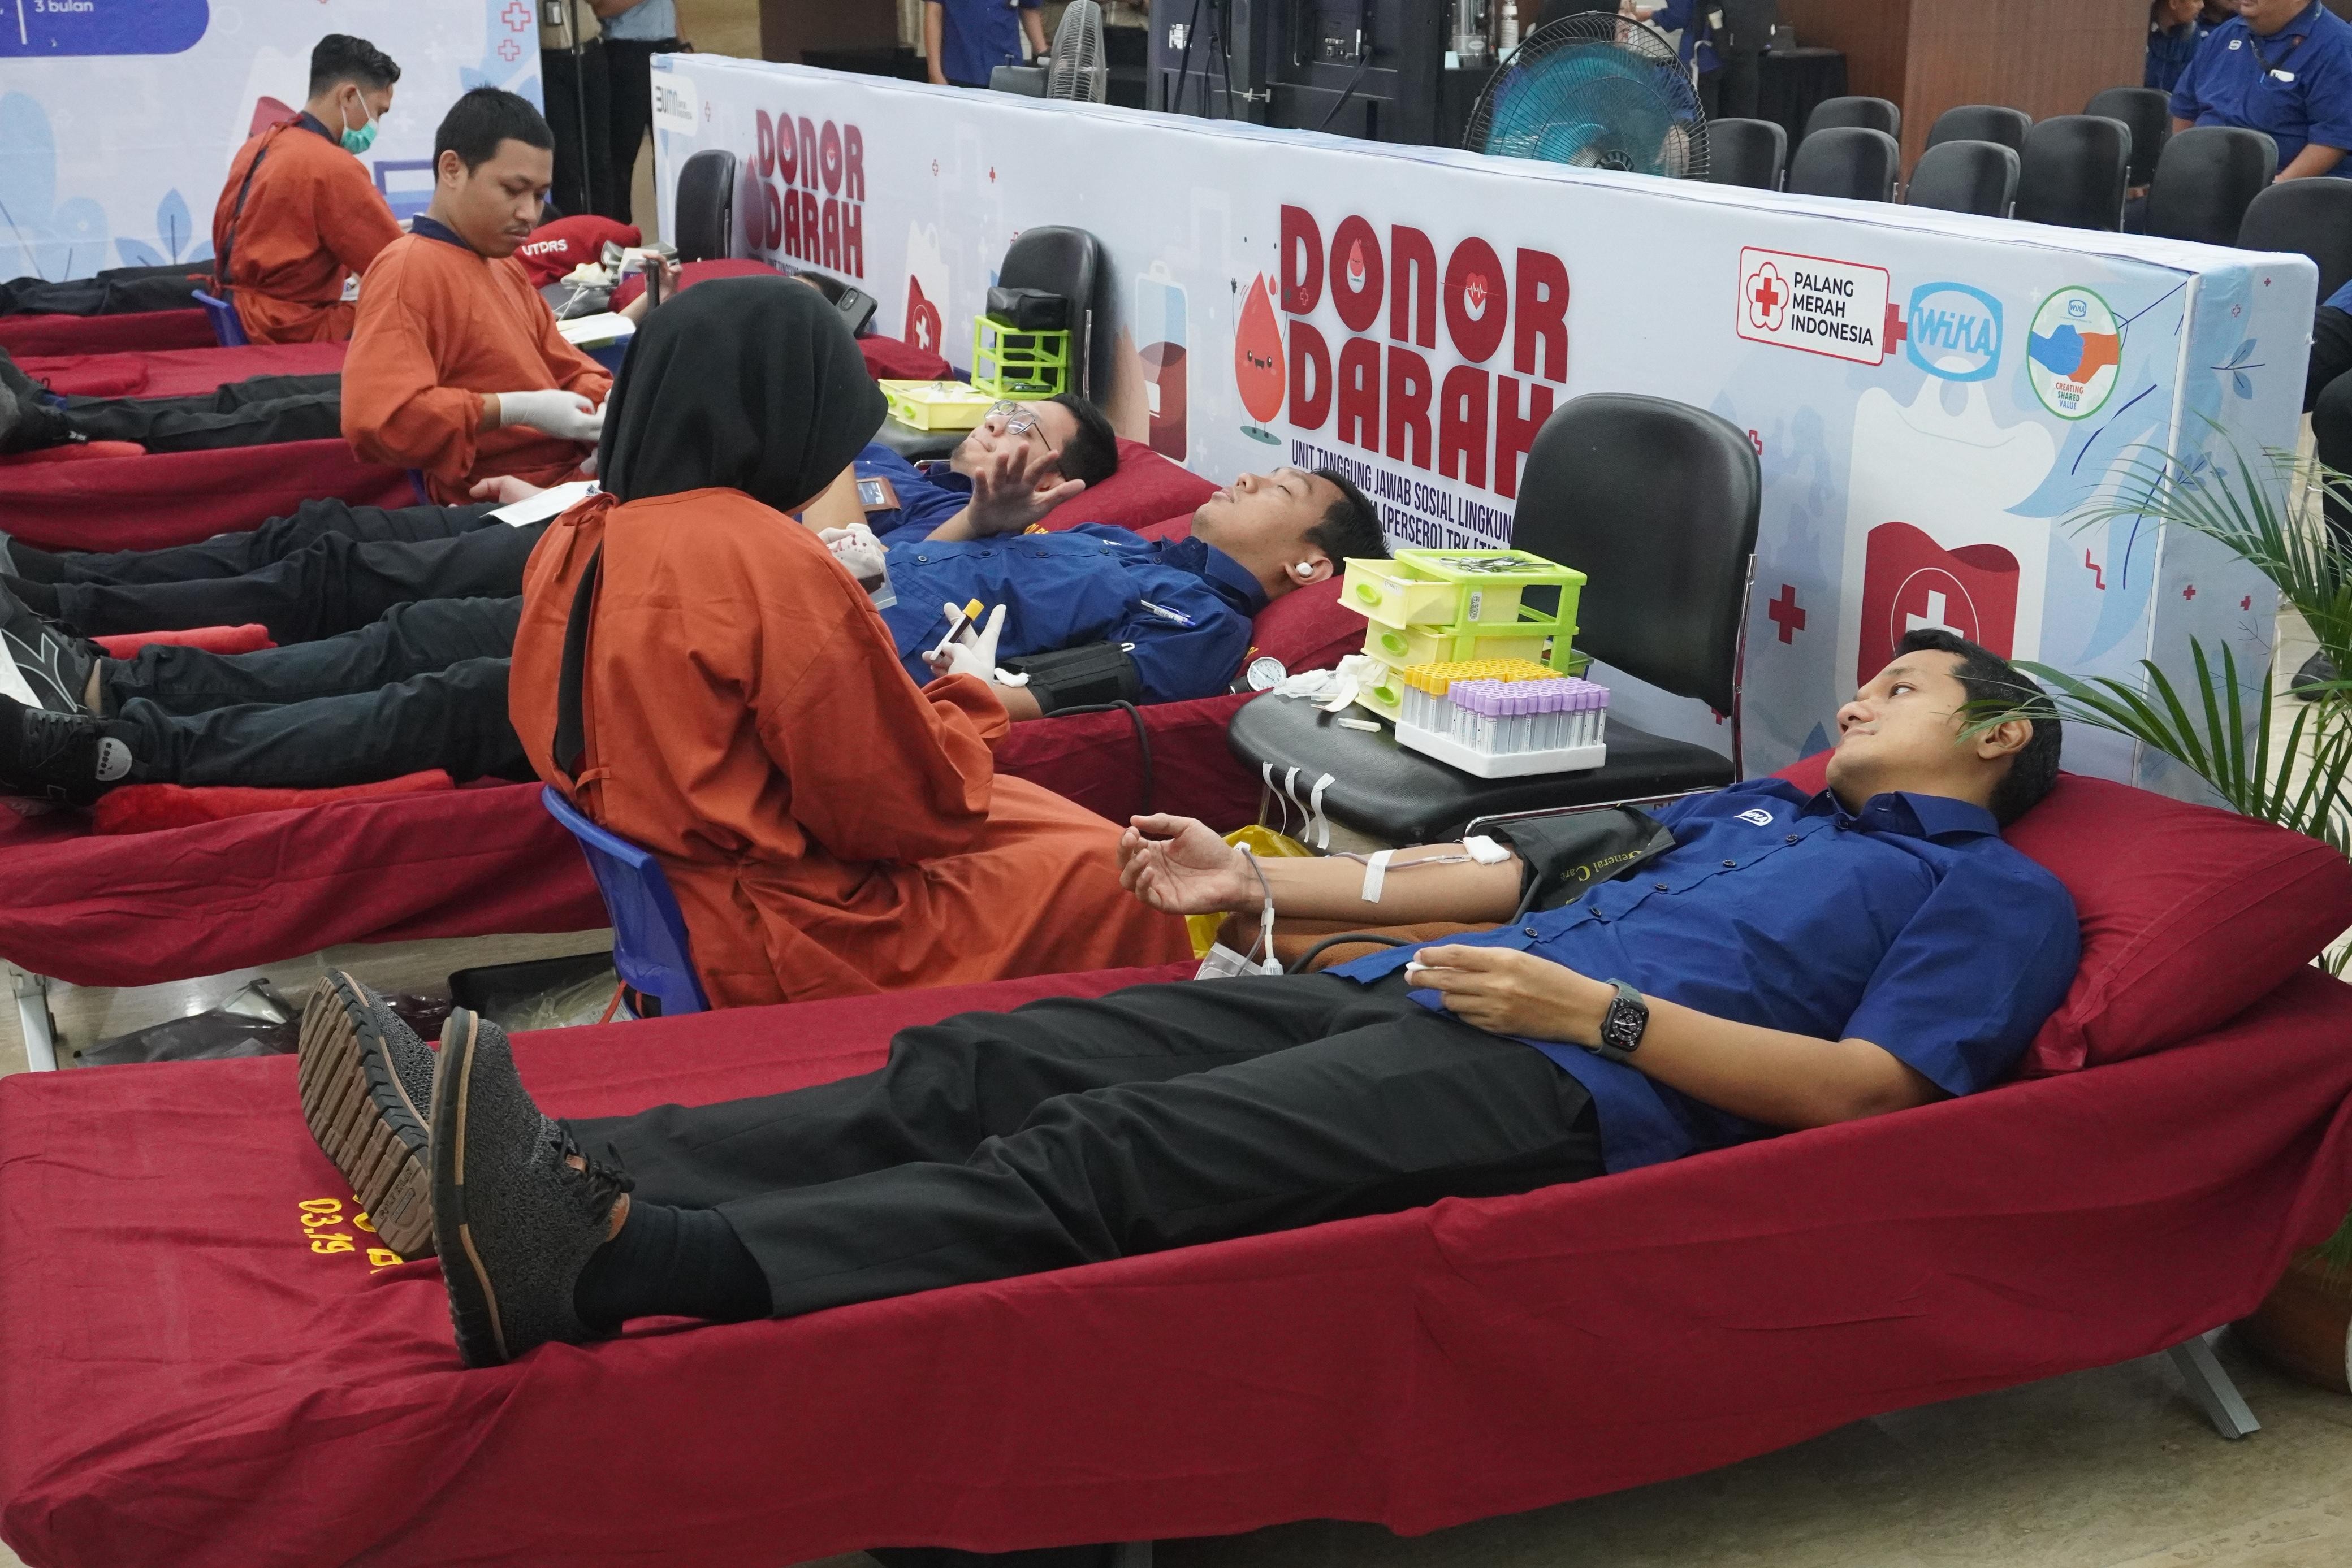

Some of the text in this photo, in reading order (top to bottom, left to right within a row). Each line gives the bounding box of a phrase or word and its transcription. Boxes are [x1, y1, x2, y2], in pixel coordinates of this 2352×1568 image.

[34, 0, 95, 12] 3 bulan
[756, 109, 864, 202] DONOR
[764, 183, 863, 279] DARAH
[521, 239, 568, 256] UTDRS
[1281, 204, 1570, 384] DONOR
[1794, 271, 1854, 297] PALANG
[1792, 293, 1845, 318] MERAH
[1791, 314, 1874, 346] INDONESIA
[2056, 382, 2084, 394] CREATING
[2058, 391, 2080, 402] SHARED
[1289, 319, 1554, 500] DARAH
[2060, 399, 2077, 410] VALUE
[1292, 439, 1315, 471] UNIT
[1317, 448, 1372, 492] TANGGUNG
[1374, 467, 1411, 506] JAWAB
[1415, 482, 1454, 523] SOSIAL
[1383, 503, 1442, 549] (PERSERO)
[1560, 865, 1590, 881] Care
[298, 1198, 355, 1254] 03.19
